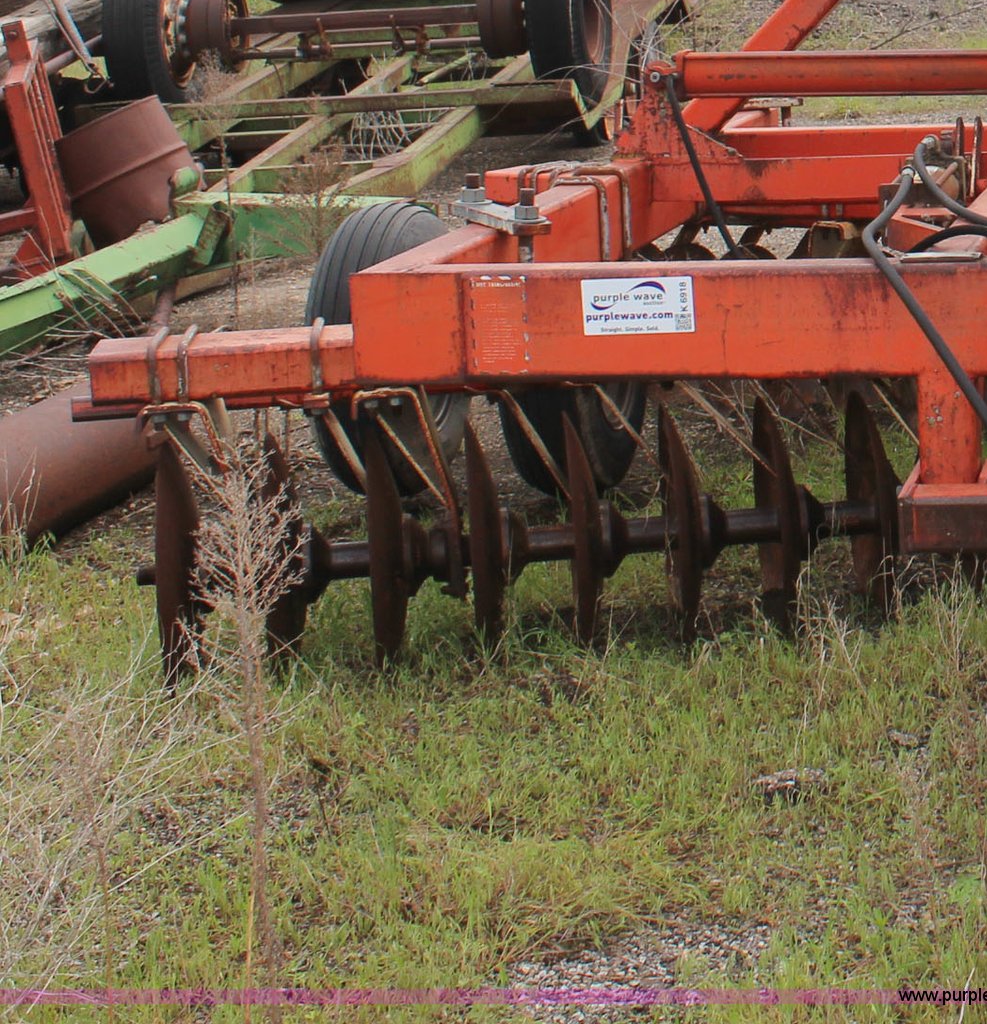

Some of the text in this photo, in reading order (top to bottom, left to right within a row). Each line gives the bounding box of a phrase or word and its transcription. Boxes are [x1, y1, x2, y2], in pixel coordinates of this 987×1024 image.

[593, 293, 663, 303] purple wave
[586, 311, 673, 323] purplewave.com
